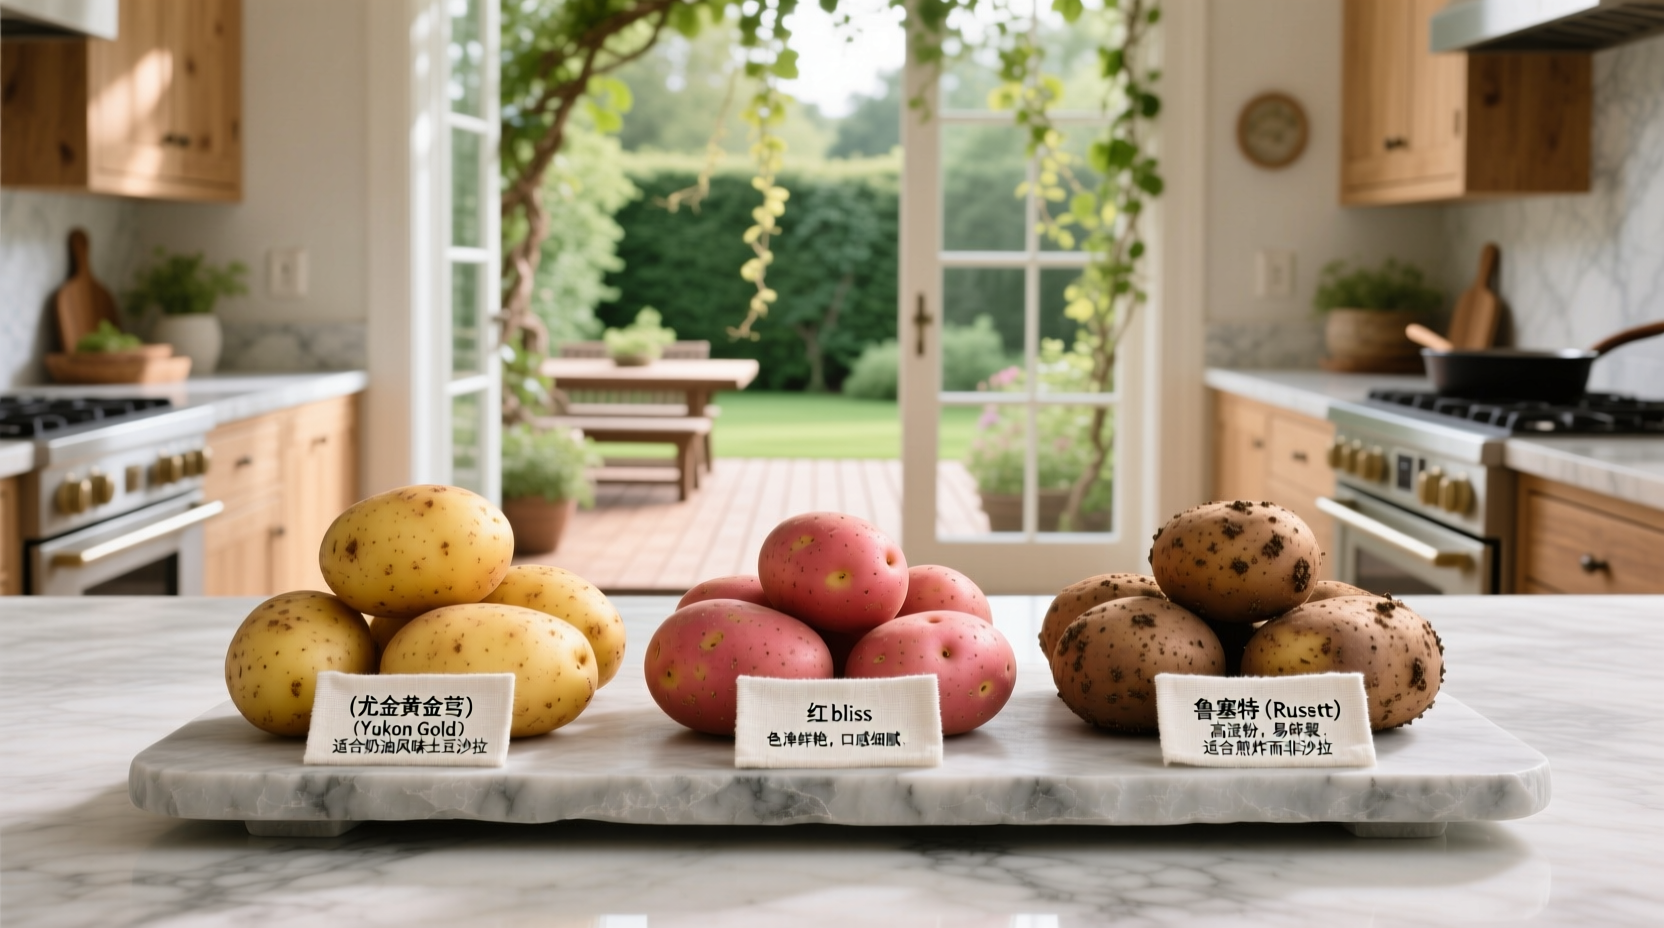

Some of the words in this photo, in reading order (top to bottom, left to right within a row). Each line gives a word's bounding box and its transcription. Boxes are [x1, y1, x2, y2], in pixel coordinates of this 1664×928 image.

[353, 720, 413, 737] (Yukon
[417, 721, 465, 737] Gold)
[332, 738, 488, 755] 适合奶油风味土豆沙拉
